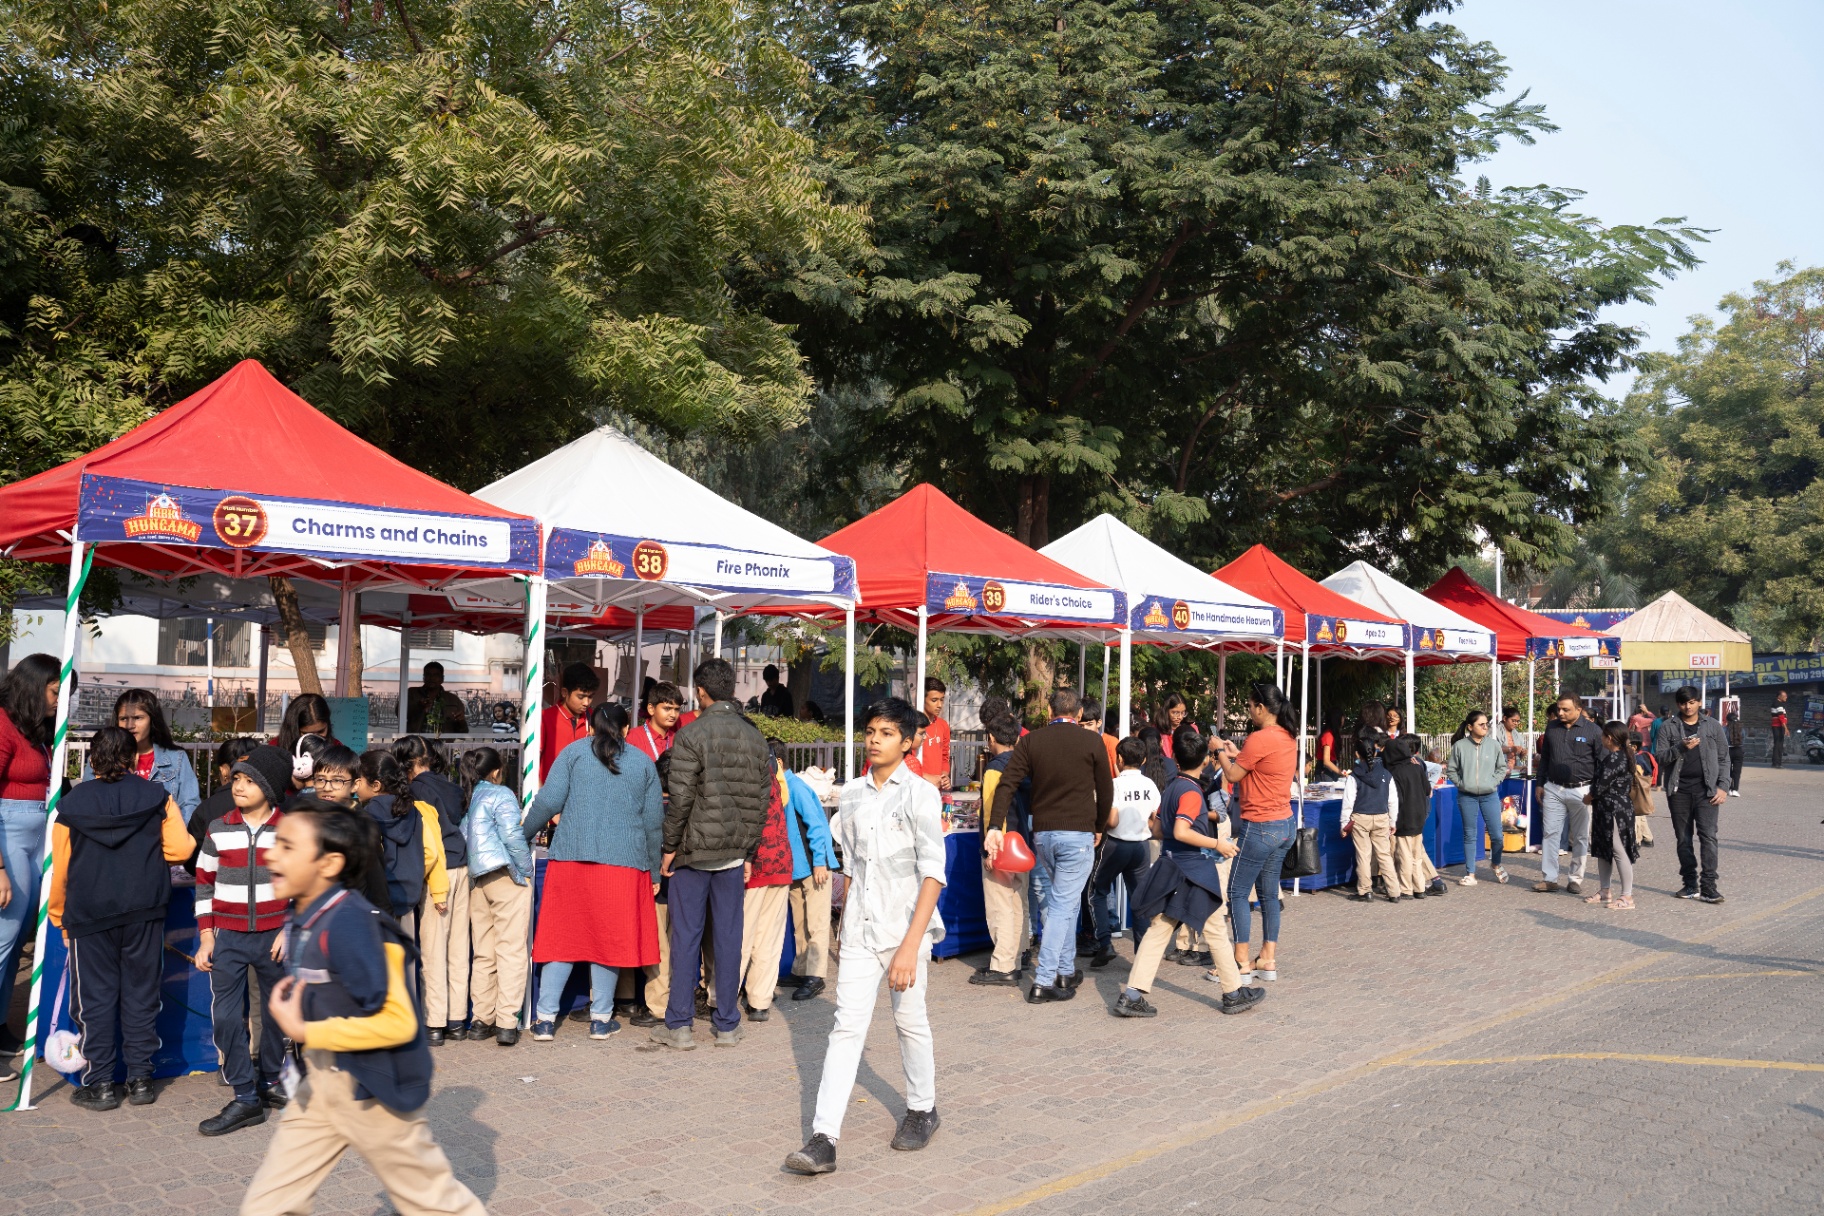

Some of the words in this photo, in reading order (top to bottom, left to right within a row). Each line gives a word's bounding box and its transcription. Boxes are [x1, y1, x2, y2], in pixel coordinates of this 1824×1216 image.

[152, 507, 176, 518] HBK
[128, 517, 197, 538] HUNGAMA
[224, 513, 257, 536] 37
[292, 517, 375, 540] Charms
[380, 527, 418, 543] and
[422, 528, 488, 547] Chains
[577, 560, 622, 574] HUNGAMA
[638, 554, 662, 574] 38
[716, 560, 742, 574] Fire
[745, 563, 790, 578] Phonix
[986, 591, 1002, 606] 39
[1030, 593, 1060, 606] Rider's
[1062, 597, 1092, 609] Choice
[1175, 610, 1188, 623] 40
[1191, 611, 1205, 621] The
[1206, 612, 1245, 624] Handmade
[1246, 616, 1271, 626] Heaven
[1337, 627, 1345, 638] 41
[1436, 636, 1444, 646] 42
[1691, 656, 1717, 666] EXIT
[1750, 662, 1775, 673] ar
[1789, 670, 1809, 680] Only
[1124, 789, 1151, 801] HBK
